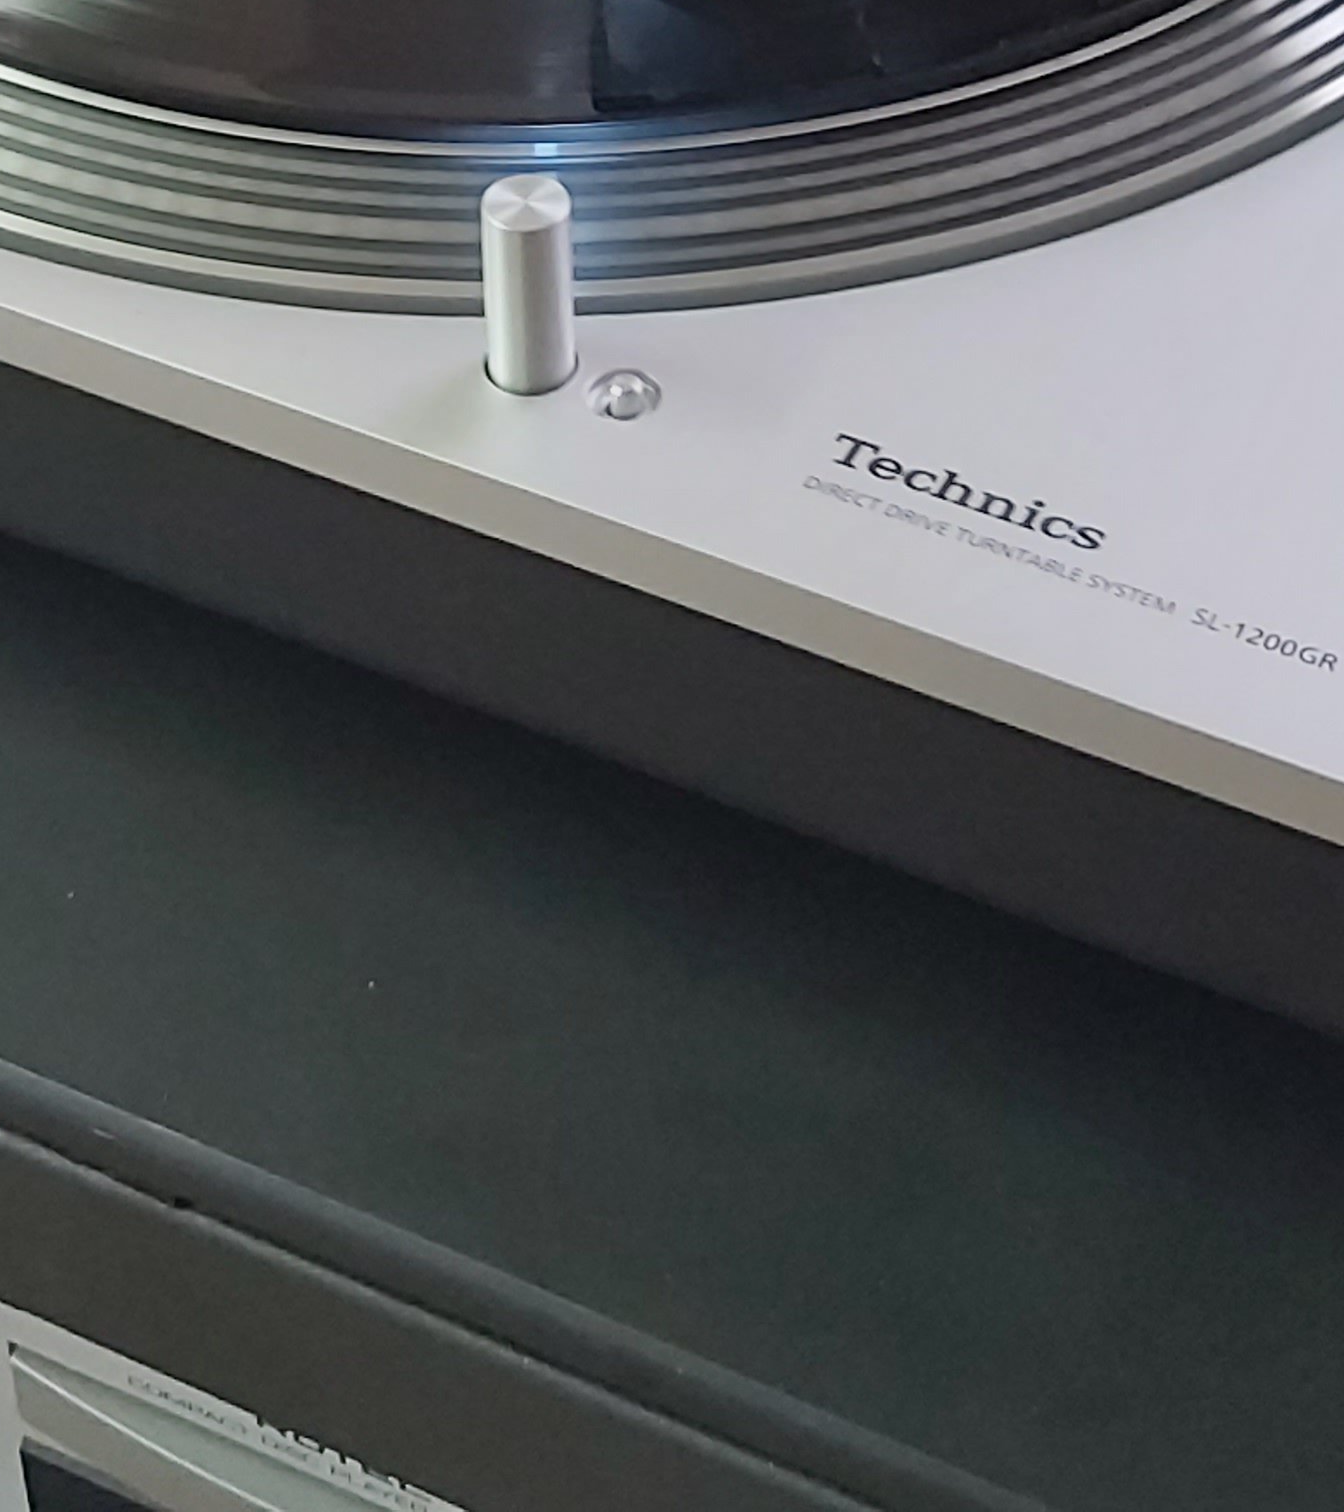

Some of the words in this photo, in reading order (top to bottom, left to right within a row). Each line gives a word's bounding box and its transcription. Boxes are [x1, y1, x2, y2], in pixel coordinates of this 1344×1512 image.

[832, 431, 1107, 551] Technics
[803, 474, 883, 510] DIRECT
[883, 503, 952, 537] DRIVE
[956, 525, 1084, 582] TURNTABLE
[1086, 573, 1177, 616] SYSTEM
[1190, 607, 1339, 672] SL-1200GR
